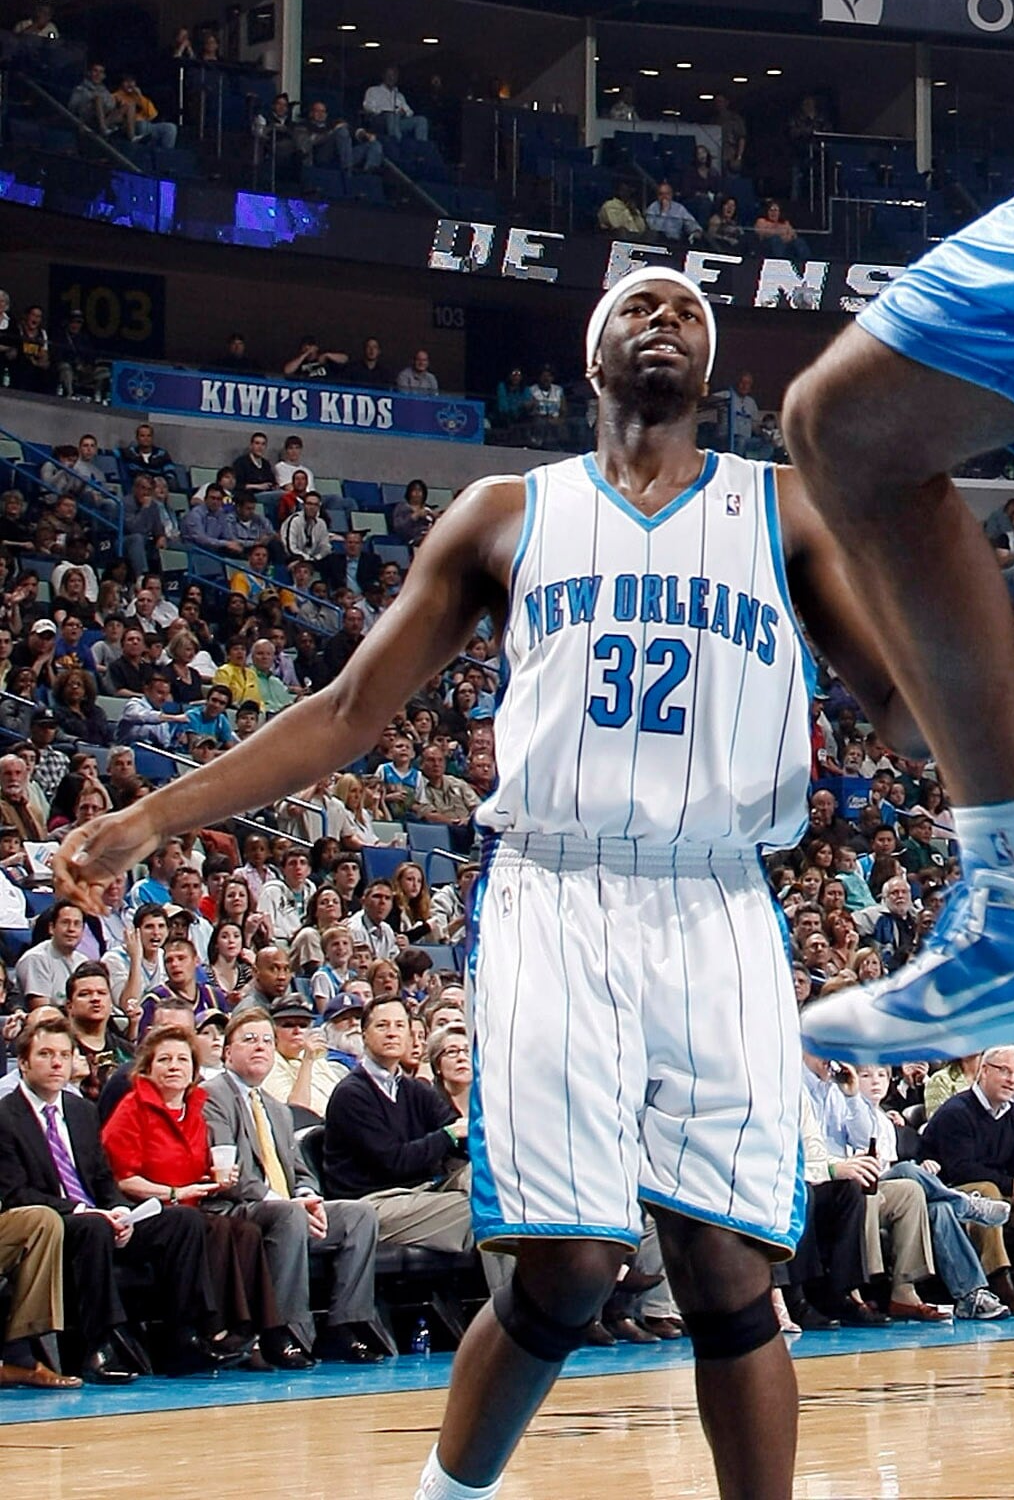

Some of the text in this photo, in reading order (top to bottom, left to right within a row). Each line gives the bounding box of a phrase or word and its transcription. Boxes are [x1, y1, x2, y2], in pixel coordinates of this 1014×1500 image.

[434, 305, 465, 328] 103
[201, 379, 393, 429] KIWI'S KIDS
[524, 573, 779, 666] NEW ORLEANS
[587, 633, 691, 735] 32
